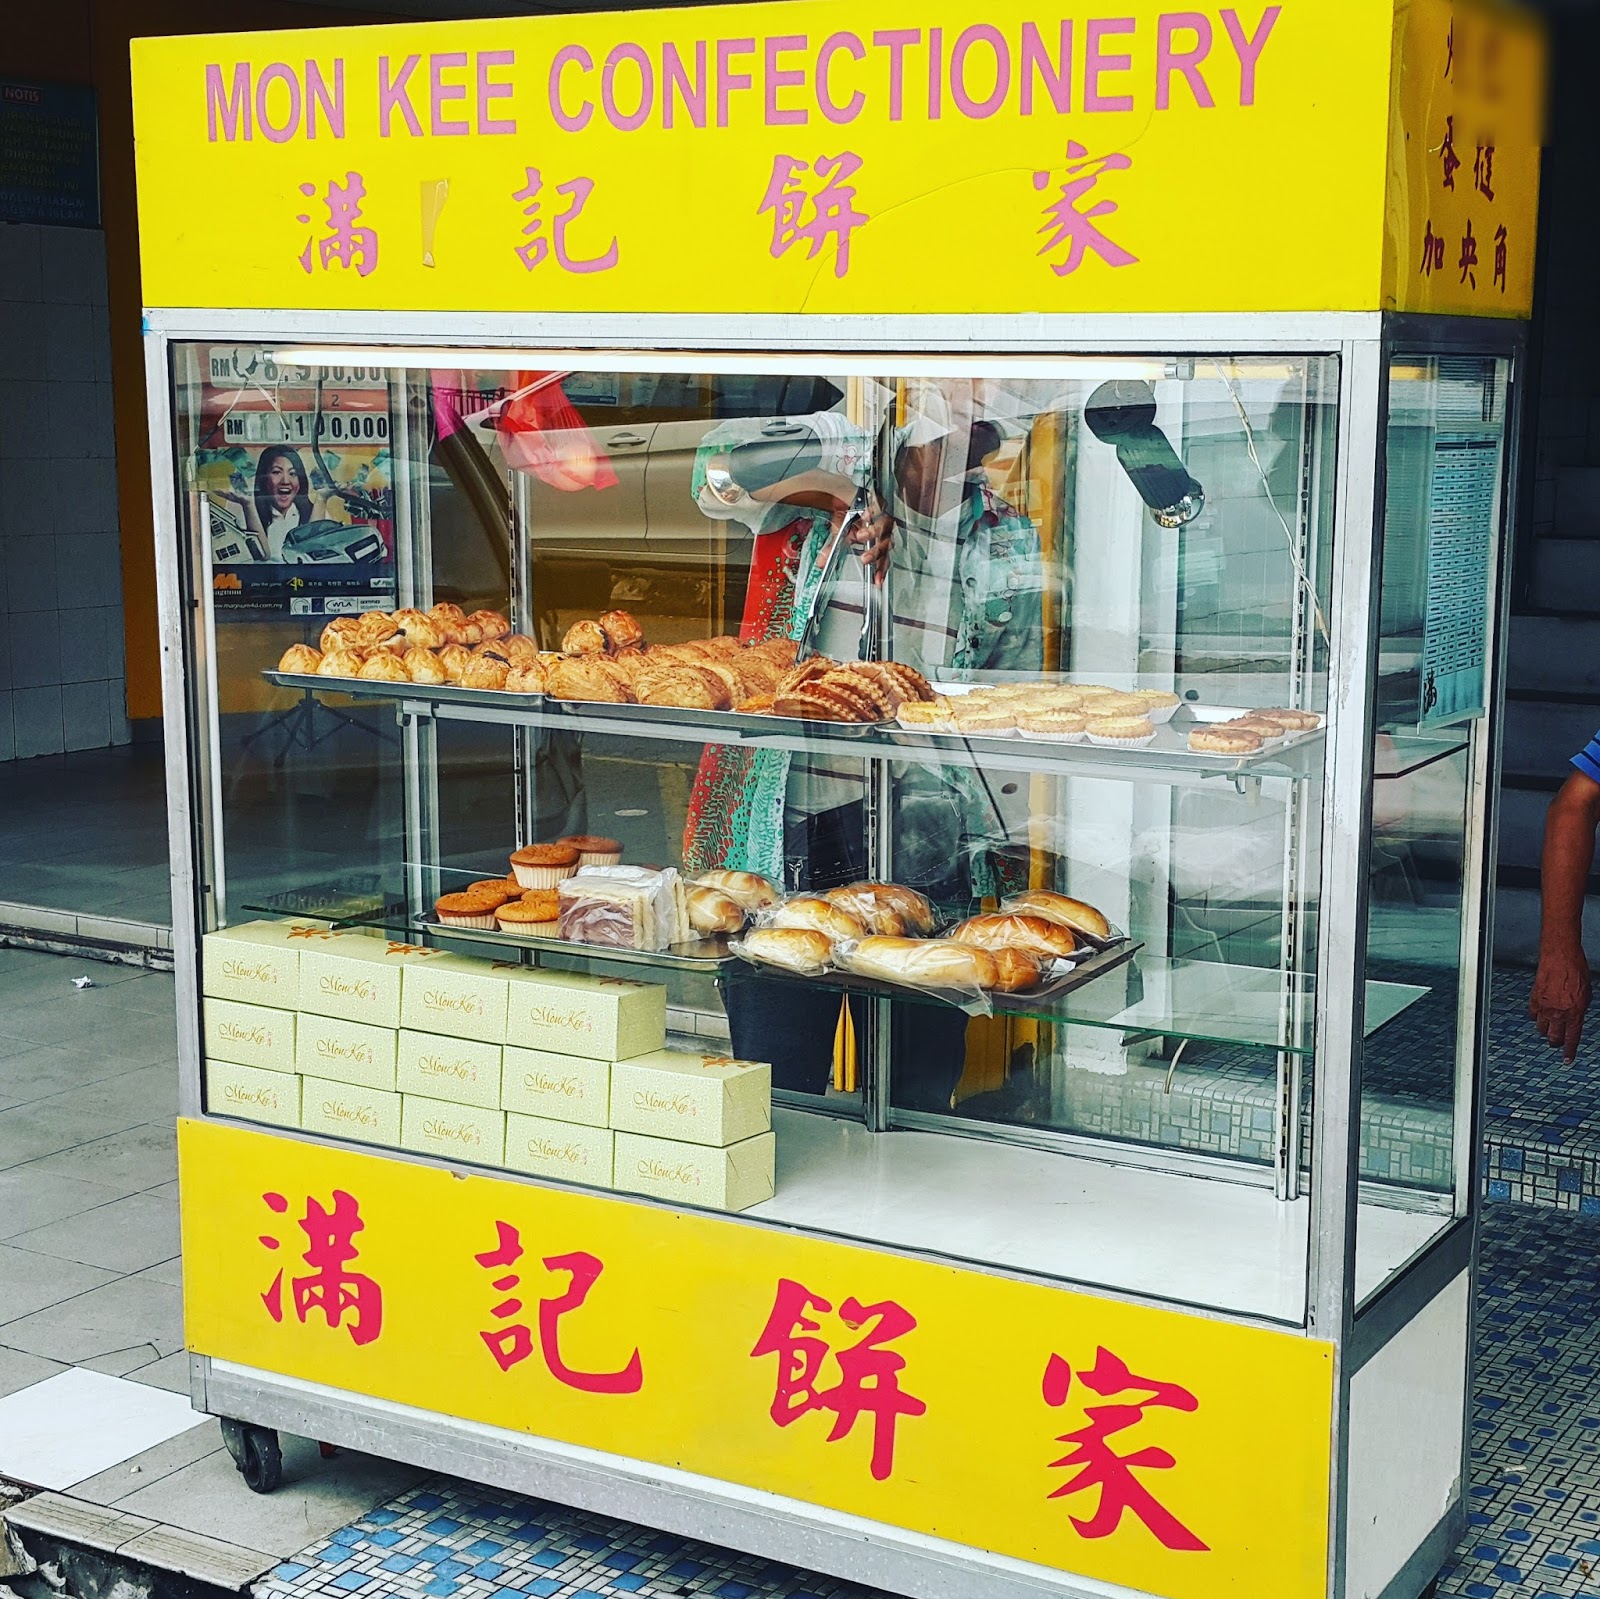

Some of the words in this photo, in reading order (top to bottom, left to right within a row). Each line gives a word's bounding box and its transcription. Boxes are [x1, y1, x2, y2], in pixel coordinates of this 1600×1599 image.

[205, 62, 345, 143] MON
[379, 50, 517, 138] KEE
[548, 5, 1281, 132] CONFECTIONERY
[1420, 218, 1508, 294] 加央角
[211, 358, 230, 377] RM
[227, 419, 243, 435] RM
[258, 1189, 1211, 1551] 滿記餅家
